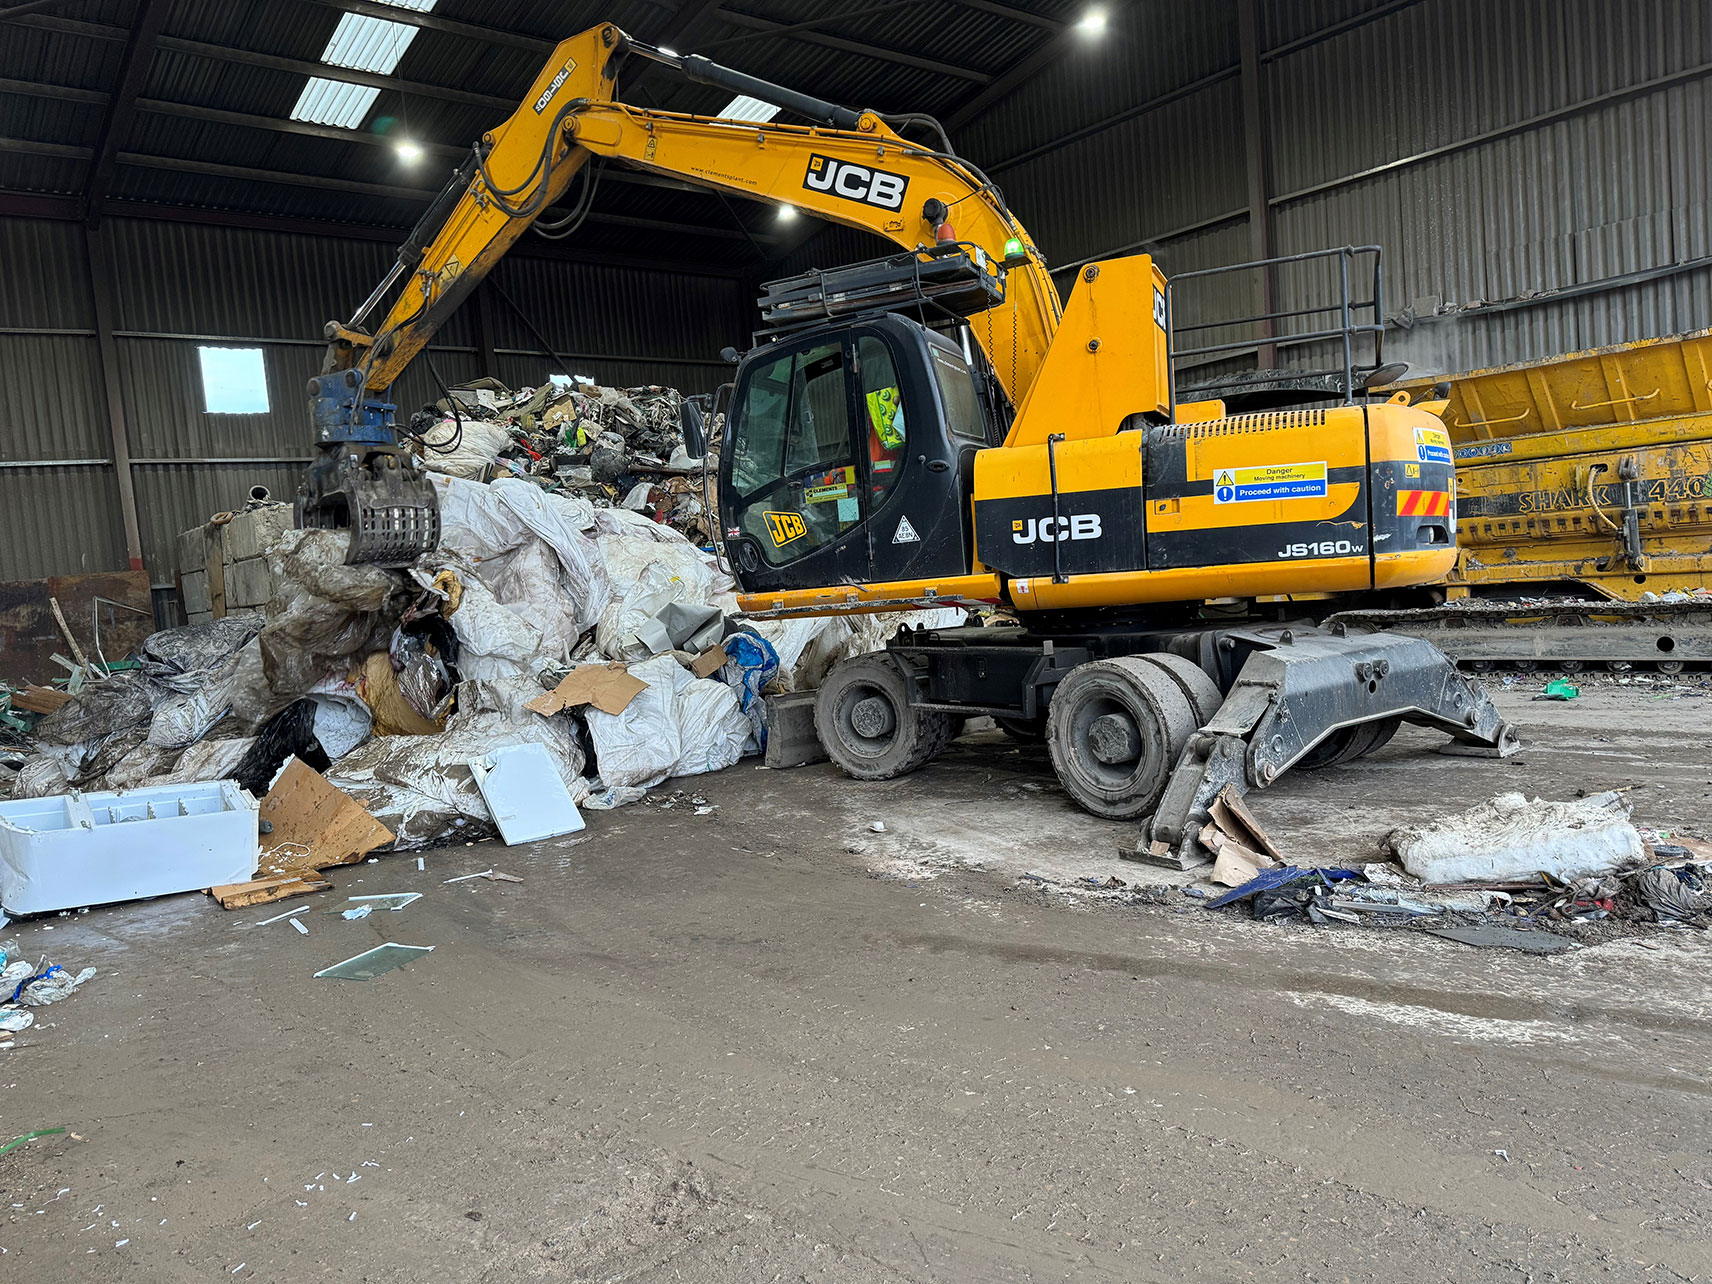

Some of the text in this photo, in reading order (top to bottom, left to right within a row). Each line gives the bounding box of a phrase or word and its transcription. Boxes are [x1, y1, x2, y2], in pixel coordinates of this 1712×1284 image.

[807, 160, 905, 208] JCB
[1153, 288, 1166, 331] JC
[1266, 468, 1293, 476] Danger
[1239, 484, 1321, 497] Proceed with caution
[1519, 486, 1611, 513] SHARK
[1648, 476, 1705, 501] 440
[770, 514, 804, 543] JCB
[1012, 514, 1103, 545] JCB
